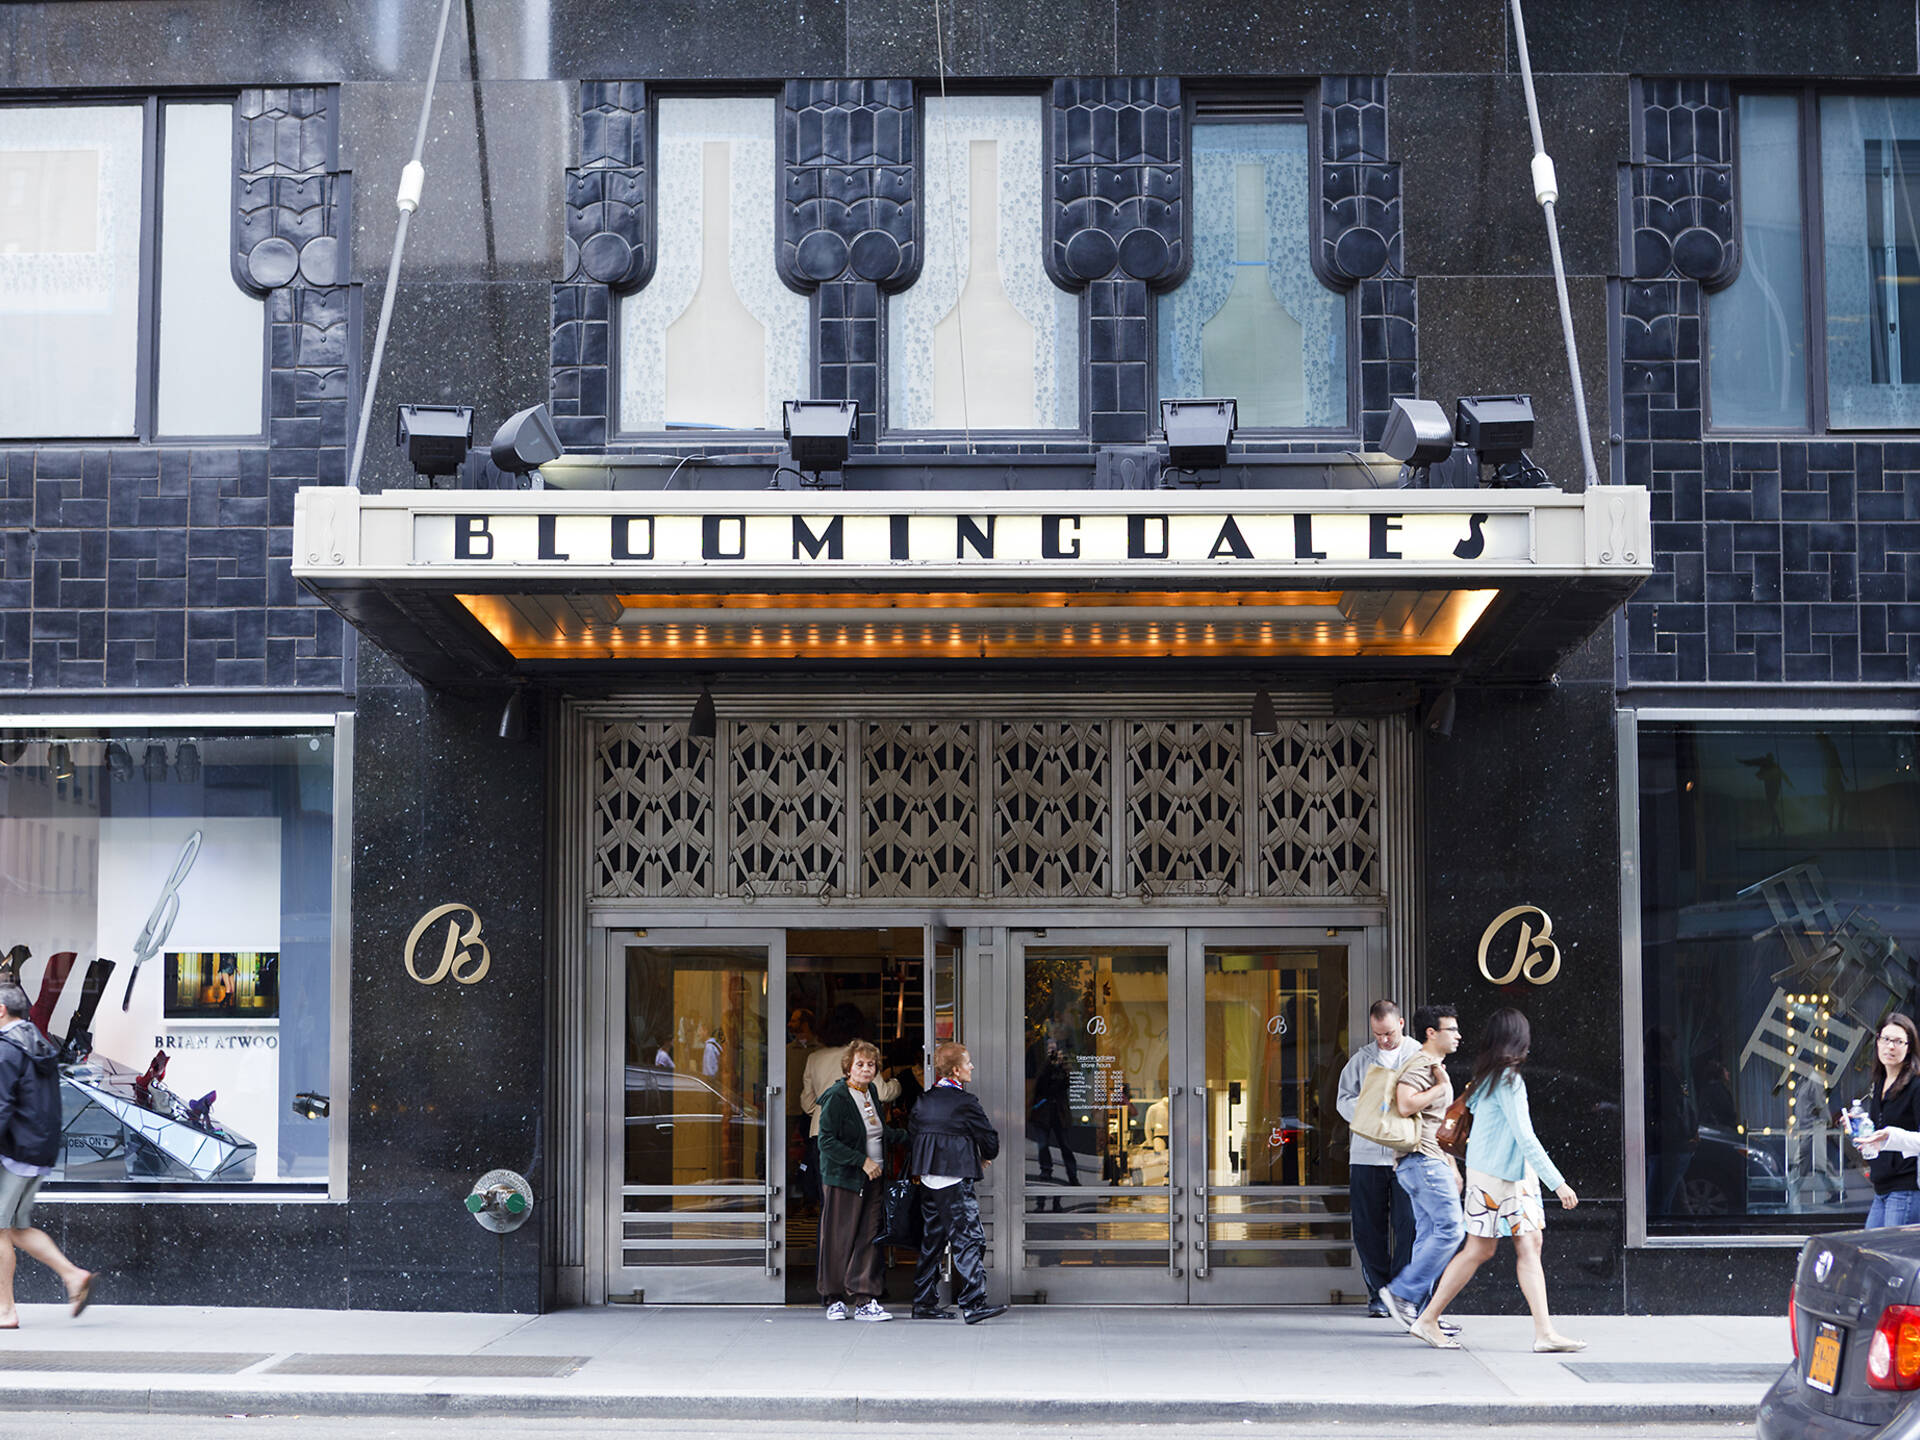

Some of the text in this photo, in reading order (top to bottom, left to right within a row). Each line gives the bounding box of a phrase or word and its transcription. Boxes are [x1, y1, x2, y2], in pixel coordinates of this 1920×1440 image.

[454, 514, 1489, 560] BLOOMINGDALES
[765, 880, 808, 895] 765
[1163, 880, 1208, 894] 743
[404, 903, 491, 985] B
[1478, 905, 1561, 985] B
[154, 1035, 209, 1049] BRIAN
